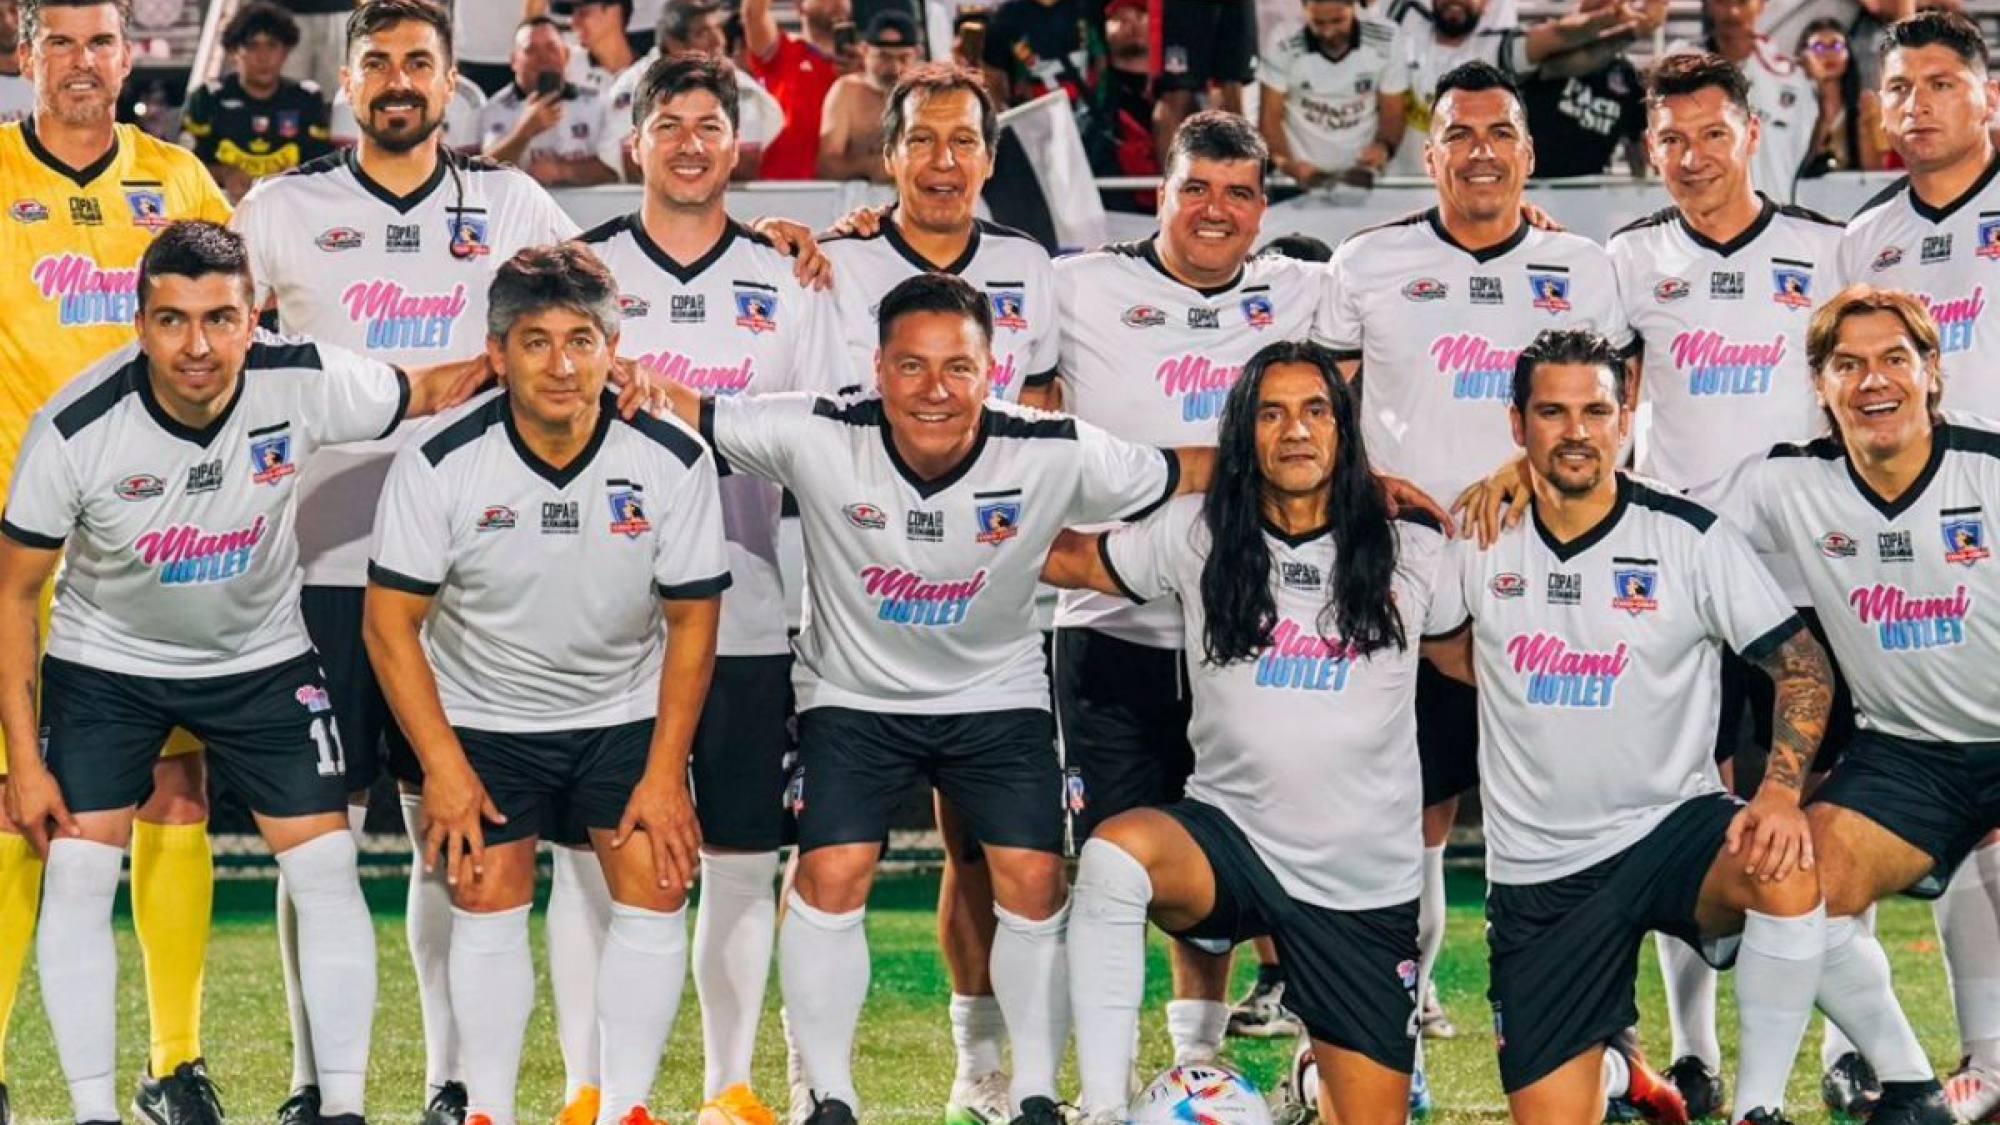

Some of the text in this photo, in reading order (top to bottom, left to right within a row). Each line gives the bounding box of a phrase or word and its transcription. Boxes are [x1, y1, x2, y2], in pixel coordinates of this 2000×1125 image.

[34, 254, 138, 296] Miam
[342, 279, 465, 322] Miami
[367, 317, 453, 348] OUTLET
[1671, 331, 1785, 370] Miami
[1689, 366, 1772, 396] OUTLET
[543, 502, 569, 518] COPA
[908, 511, 934, 526] COPA
[135, 516, 266, 564] Miami
[160, 549, 250, 584] OUTLET
[861, 566, 985, 603] Miami
[878, 596, 970, 625] OUTLET
[1850, 584, 1970, 624] Miami
[1880, 617, 1963, 650] OUTLET
[1256, 655, 1350, 690] OUTLET
[1507, 633, 1628, 677] Miami
[1527, 674, 1616, 707] OUTLET
[310, 716, 346, 776] 11
